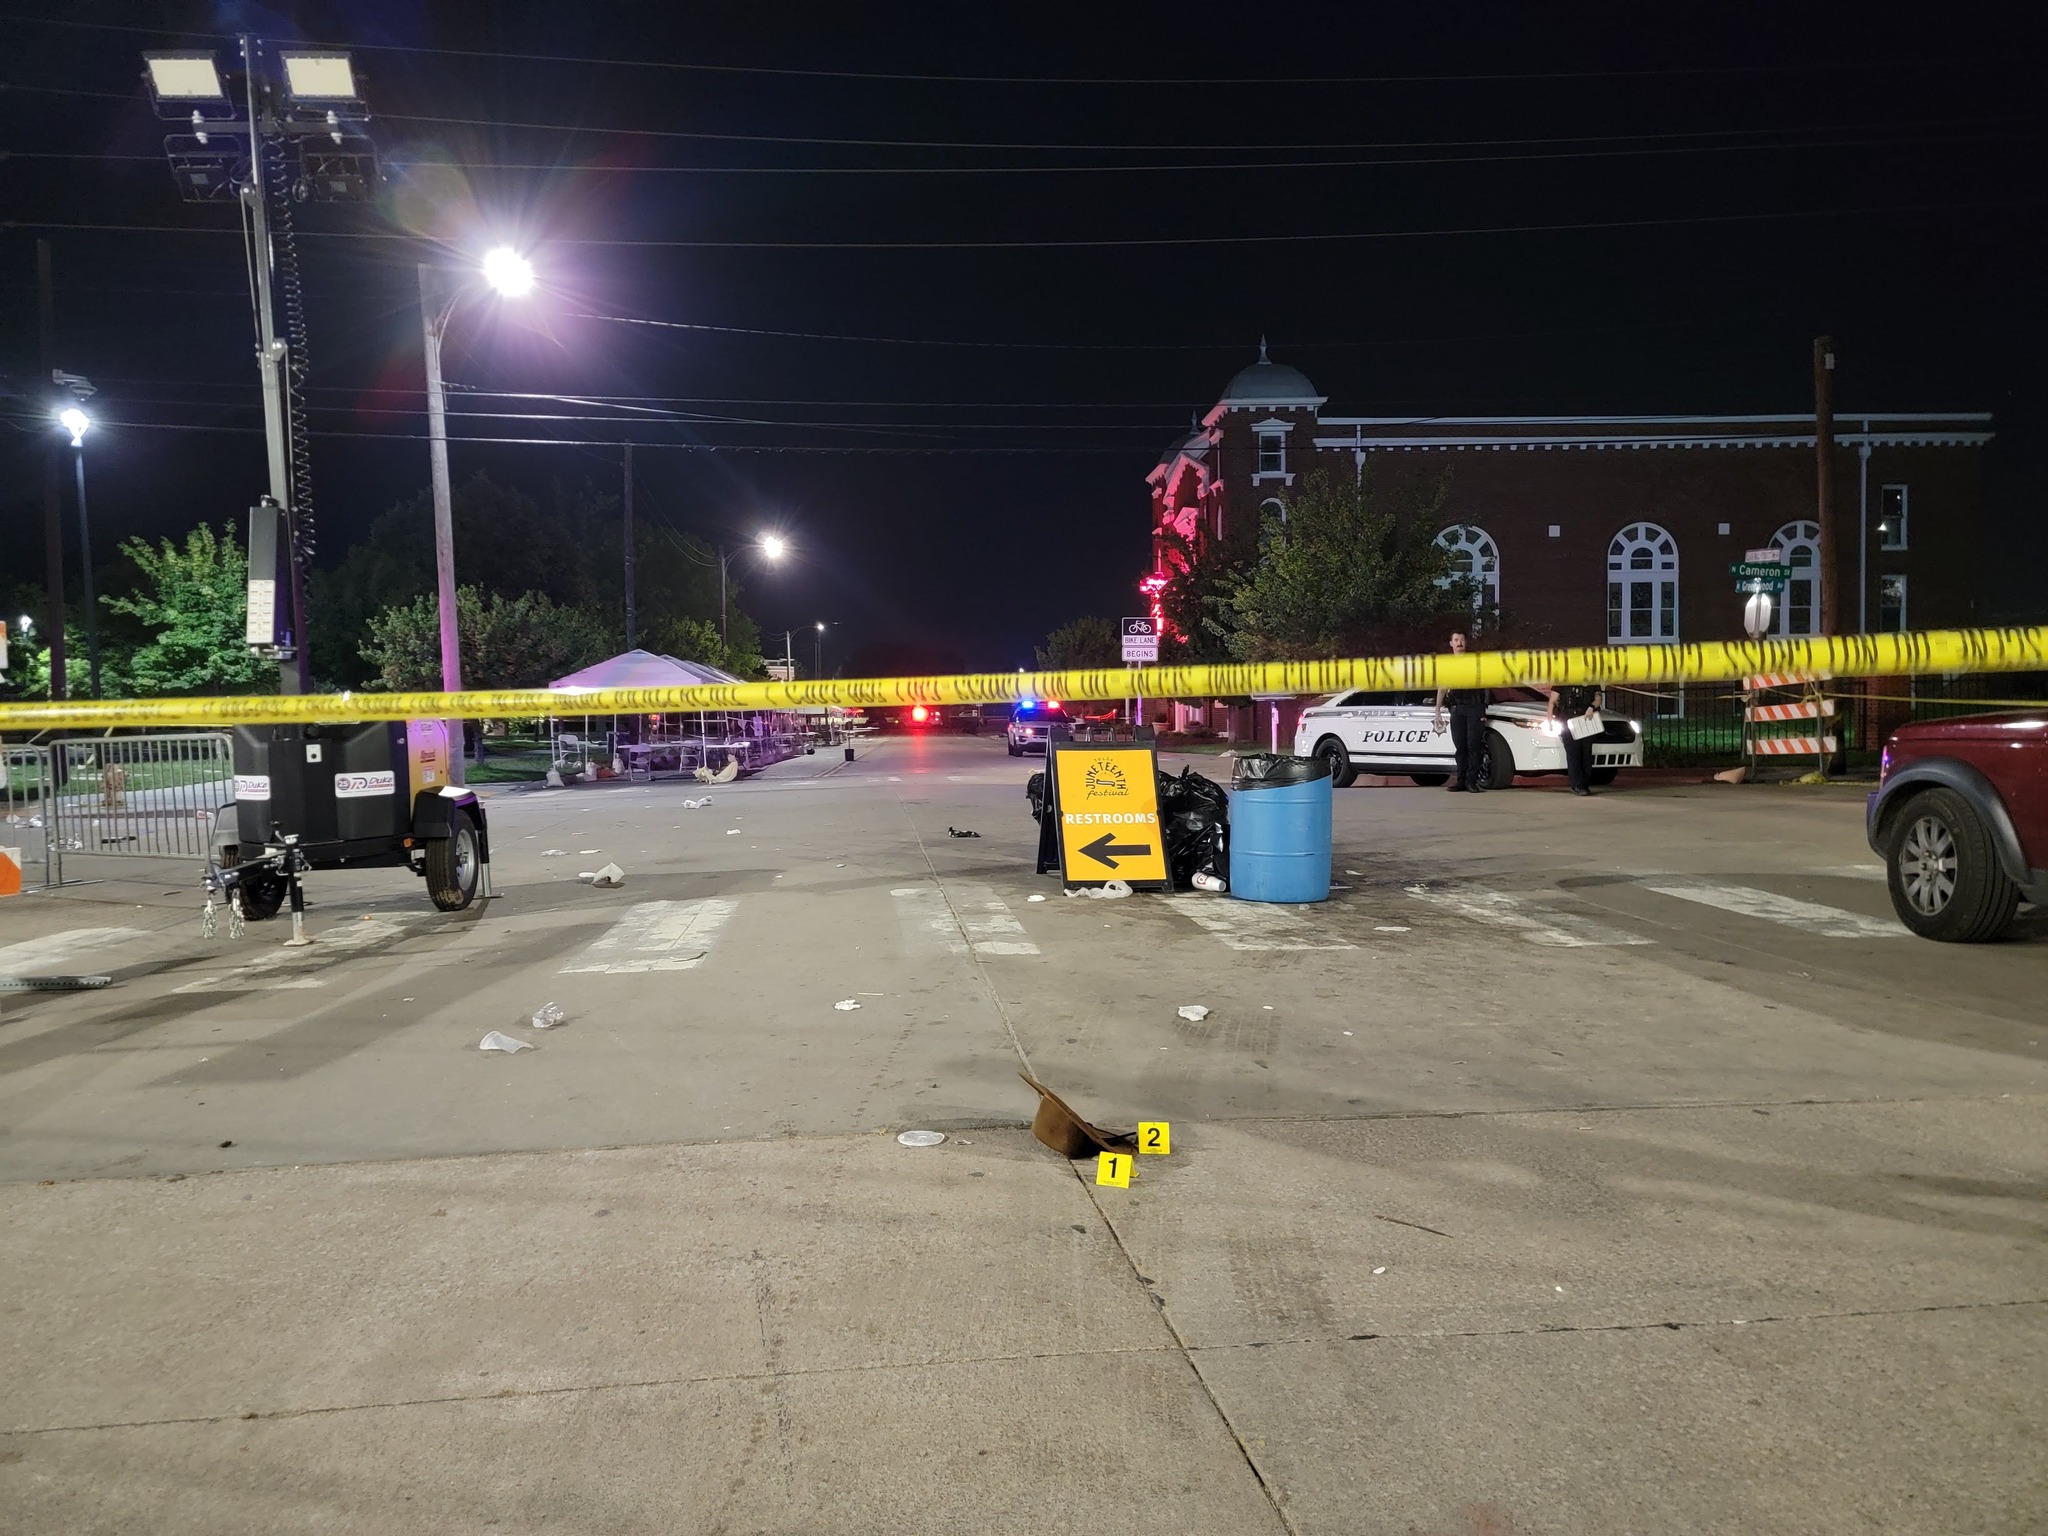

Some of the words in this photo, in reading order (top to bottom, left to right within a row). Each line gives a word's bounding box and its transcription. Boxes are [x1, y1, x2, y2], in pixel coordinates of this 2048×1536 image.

[1739, 564, 1781, 577] Cameron
[1742, 581, 1774, 592] Greeood
[1126, 650, 1154, 658] BEGINS
[1362, 730, 1431, 743] POLICE
[1085, 762, 1126, 790] JUNETEENTH
[1086, 788, 1130, 800] festival
[1065, 813, 1156, 825] RESTROOMS
[1147, 1127, 1161, 1147] 2
[1108, 1157, 1118, 1179] 1
